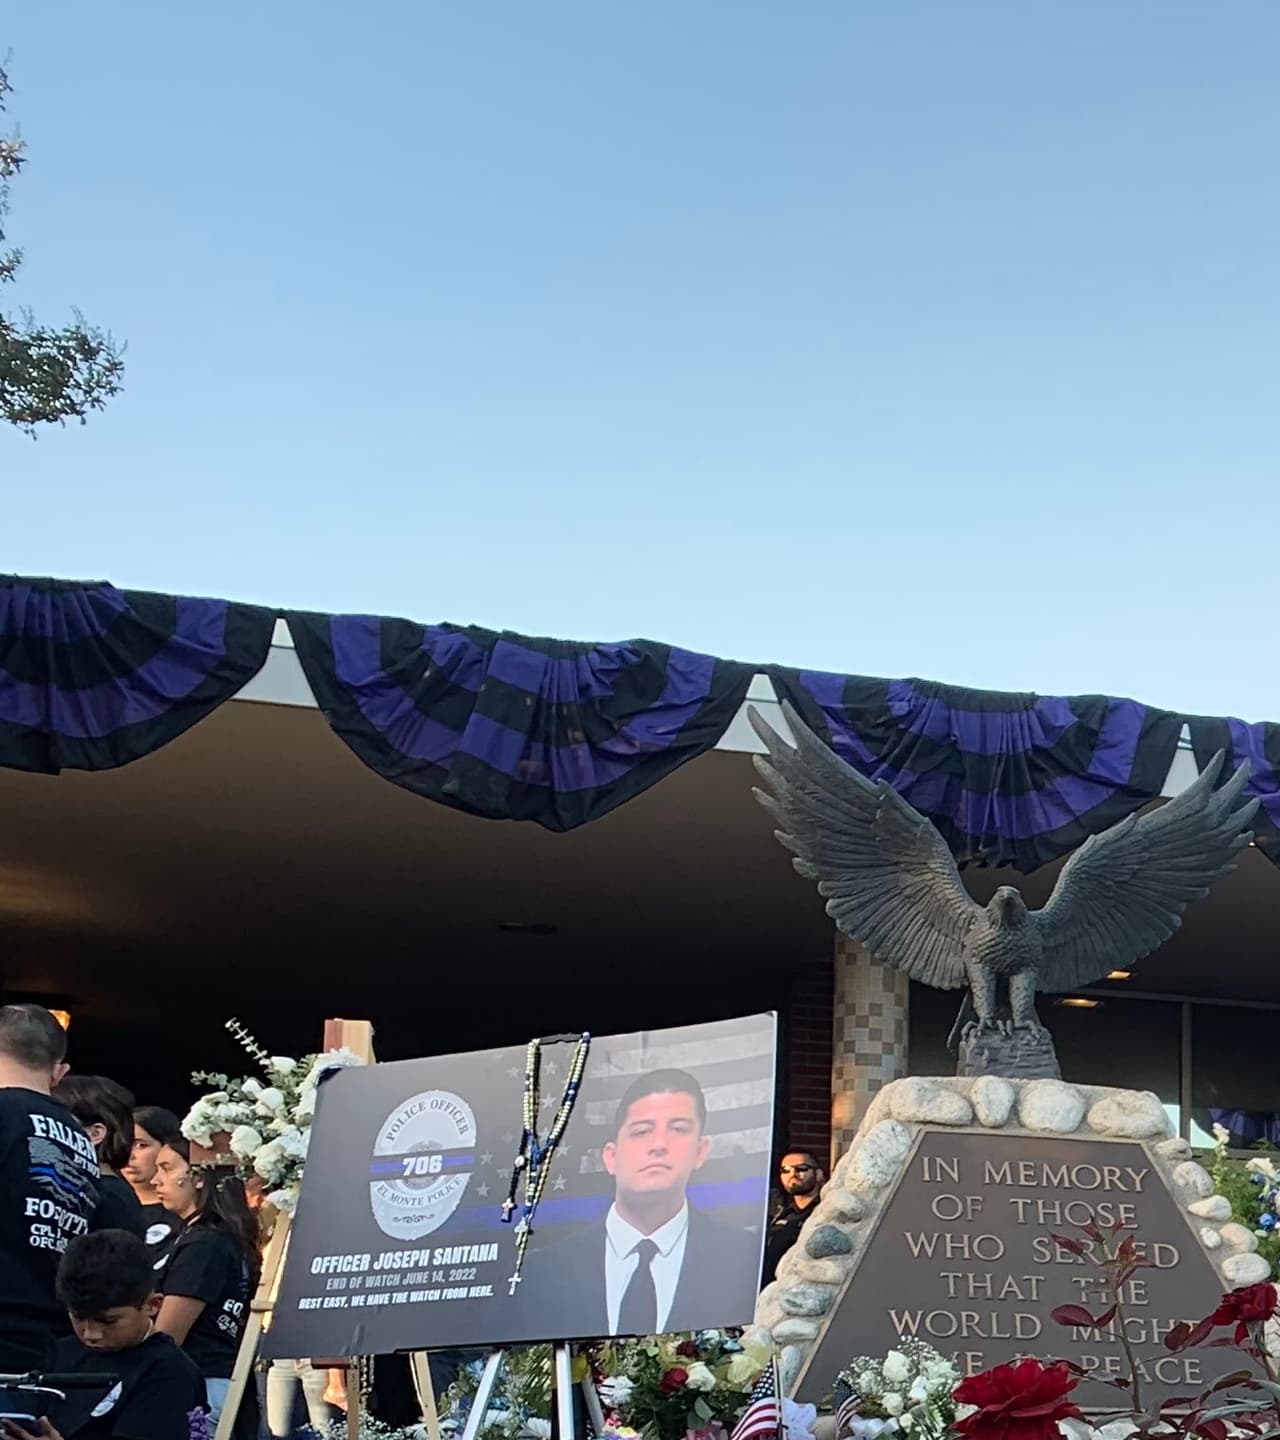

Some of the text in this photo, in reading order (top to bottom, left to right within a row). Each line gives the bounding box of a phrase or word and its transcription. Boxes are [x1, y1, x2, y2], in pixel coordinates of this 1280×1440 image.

[386, 1099, 469, 1141] POLICE OFFICER
[29, 1114, 98, 1164] FALLEN
[402, 1155, 443, 1176] 706
[921, 1156, 1150, 1193] IN MEMORY
[377, 1177, 462, 1207] EL MONTE POLICE
[932, 1193, 1138, 1230] OF THOSE
[311, 1243, 499, 1274] OFFICER JOSEPH SANTANA
[903, 1231, 1005, 1261] WHO
[326, 1277, 347, 1291] END
[349, 1276, 362, 1289] OF
[365, 1273, 401, 1288] WATCH
[402, 1271, 429, 1285] JUNE
[449, 1268, 477, 1281] 2022
[940, 1272, 1149, 1305] THAT THE
[298, 1297, 322, 1310] REST
[351, 1295, 366, 1307] WE
[366, 1294, 390, 1306] HAVE
[392, 1292, 408, 1304] THE
[409, 1290, 440, 1303] WATCH
[442, 1287, 467, 1300] FROM
[469, 1285, 494, 1298] HERE.
[889, 1309, 1043, 1339] WORLD
[1079, 1355, 1204, 1385] PEACE
